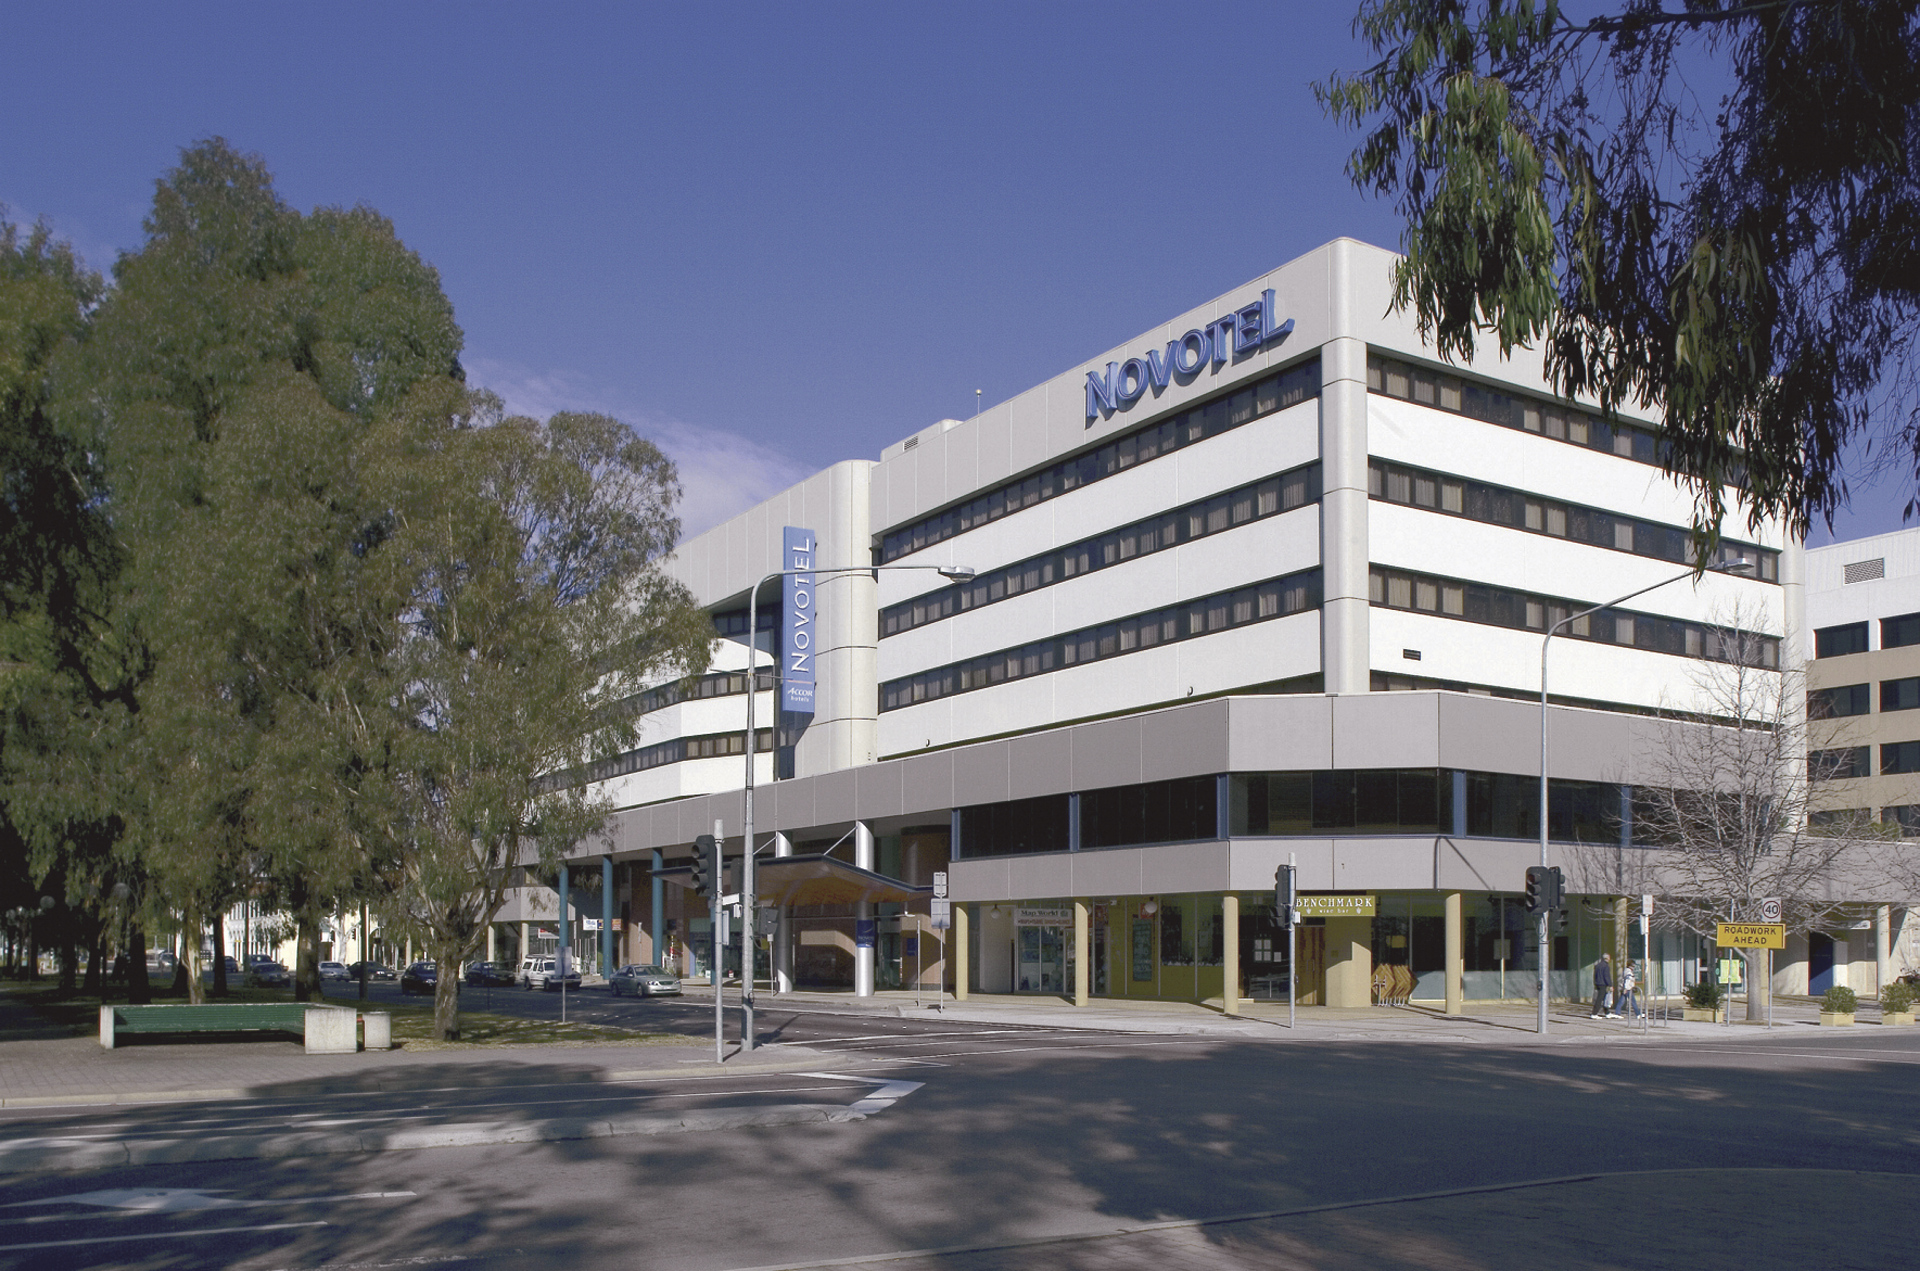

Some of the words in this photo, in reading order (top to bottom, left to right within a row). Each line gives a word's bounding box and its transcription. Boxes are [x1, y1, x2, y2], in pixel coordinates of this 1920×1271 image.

[1086, 288, 1296, 419] NOVOTEL
[791, 537, 810, 673] NOVOTEL
[1296, 898, 1372, 907] BENCHMARK
[1765, 905, 1779, 915] 40
[1724, 926, 1777, 935] ROADWORK
[1733, 936, 1767, 944] AHEAD
